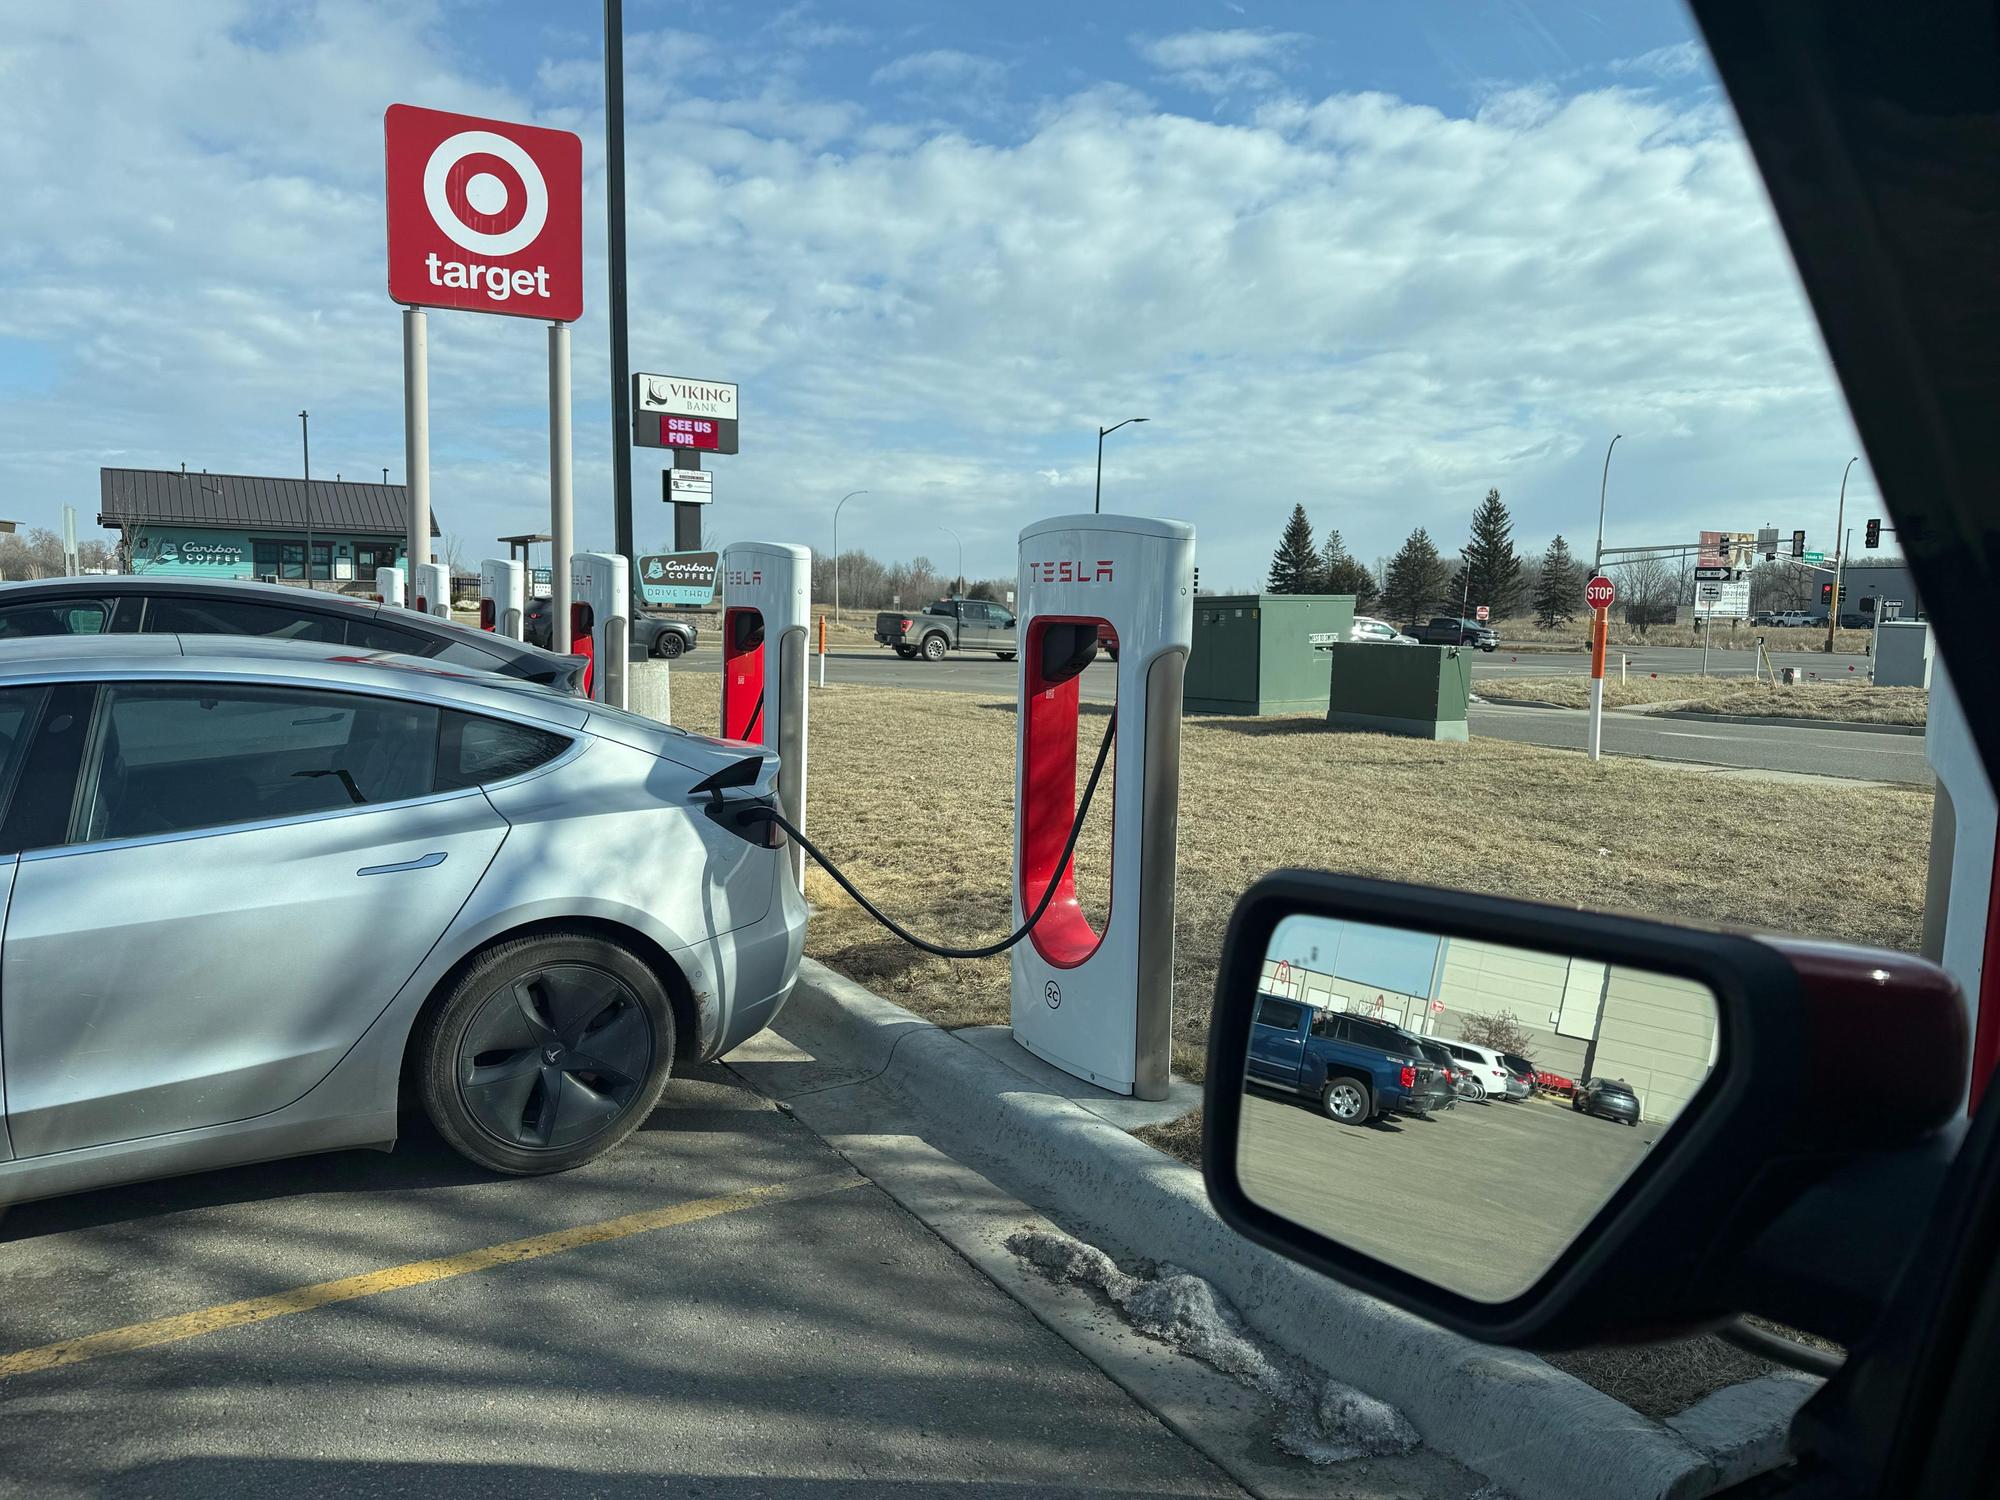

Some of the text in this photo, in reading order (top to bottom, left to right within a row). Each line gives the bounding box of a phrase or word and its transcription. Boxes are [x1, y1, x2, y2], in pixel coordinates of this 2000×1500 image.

[425, 252, 550, 301] target
[670, 383, 731, 404] VIKING
[686, 400, 719, 413] BANK
[668, 418, 712, 433] SEE US
[668, 432, 694, 445] FOR
[182, 541, 242, 554] Caribou
[186, 553, 240, 562] COFFEE
[665, 560, 715, 573] Caribou
[1030, 560, 1114, 583] TESLA
[668, 571, 712, 580] COFFEE
[647, 588, 710, 598] DRIVE THRU
[1587, 586, 1613, 600] STOP
[1047, 987, 1059, 1002] 2C
